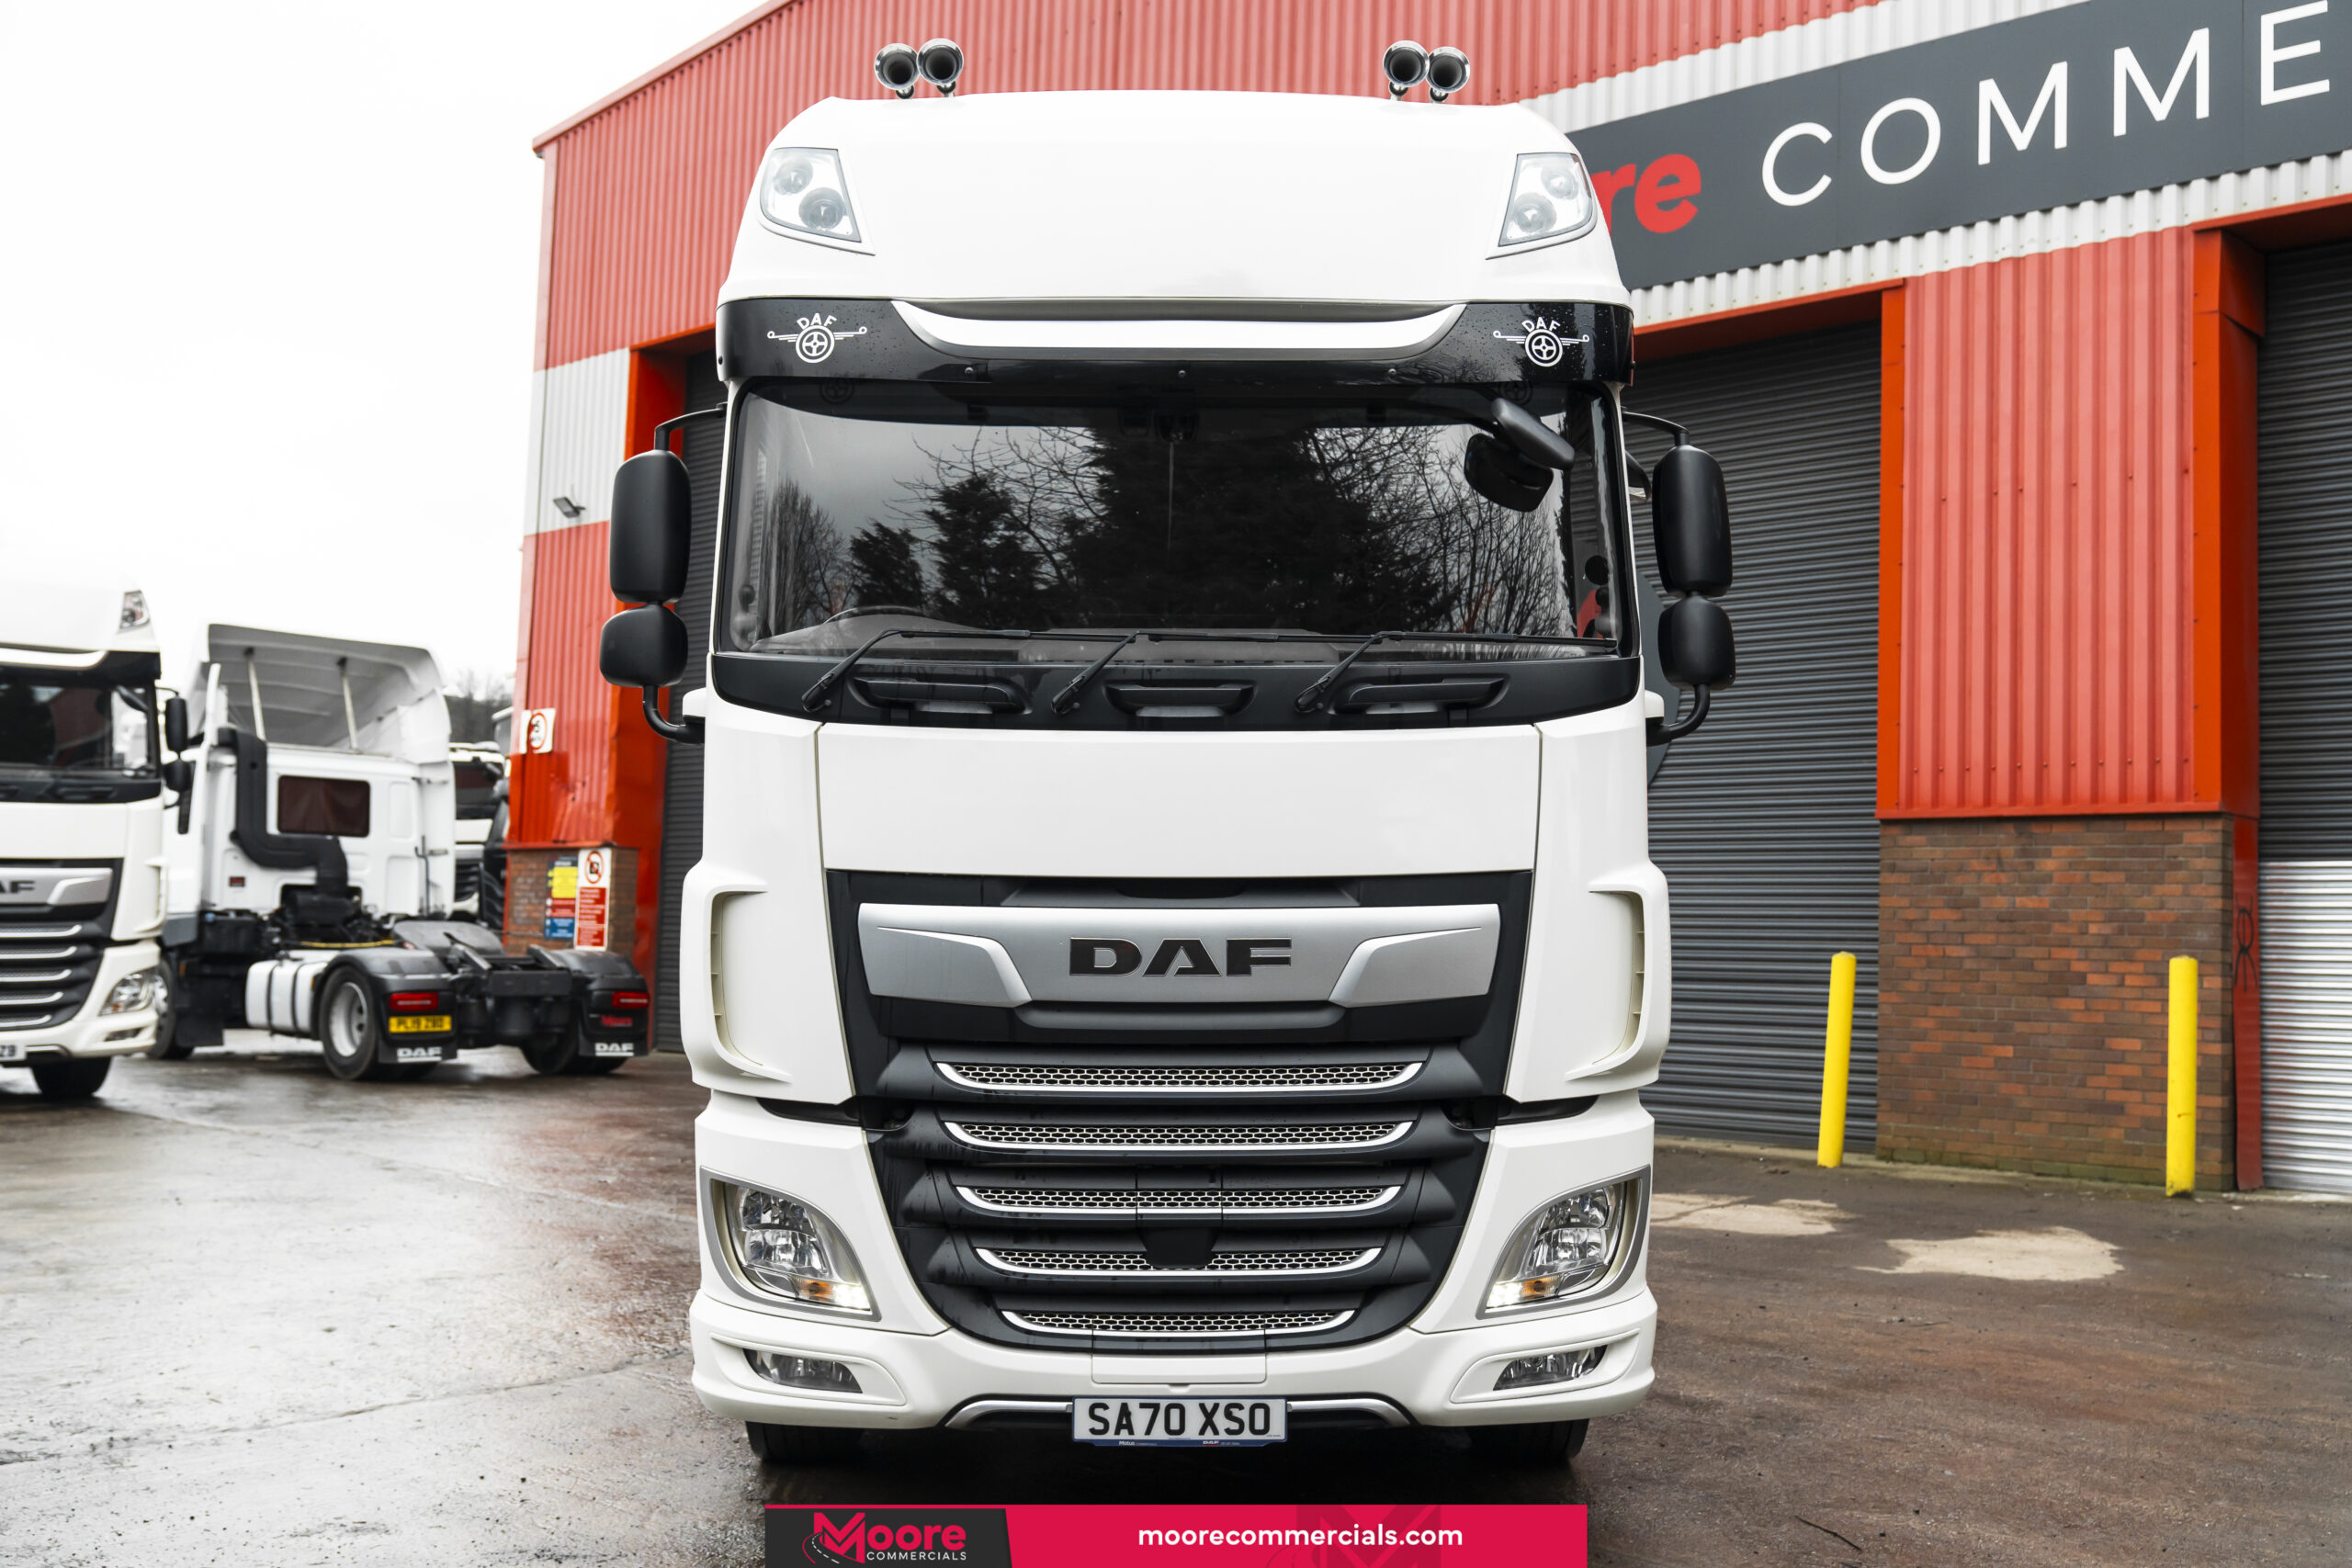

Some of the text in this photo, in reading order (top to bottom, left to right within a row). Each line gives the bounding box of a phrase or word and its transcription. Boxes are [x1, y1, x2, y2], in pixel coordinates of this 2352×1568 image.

[797, 312, 837, 330] DAF
[1521, 317, 1561, 333] DAF
[1069, 937, 1292, 976] DAF
[397, 1046, 442, 1057] DAF
[594, 1043, 634, 1052] DAF
[1088, 1402, 1271, 1436] SA70 XSO
